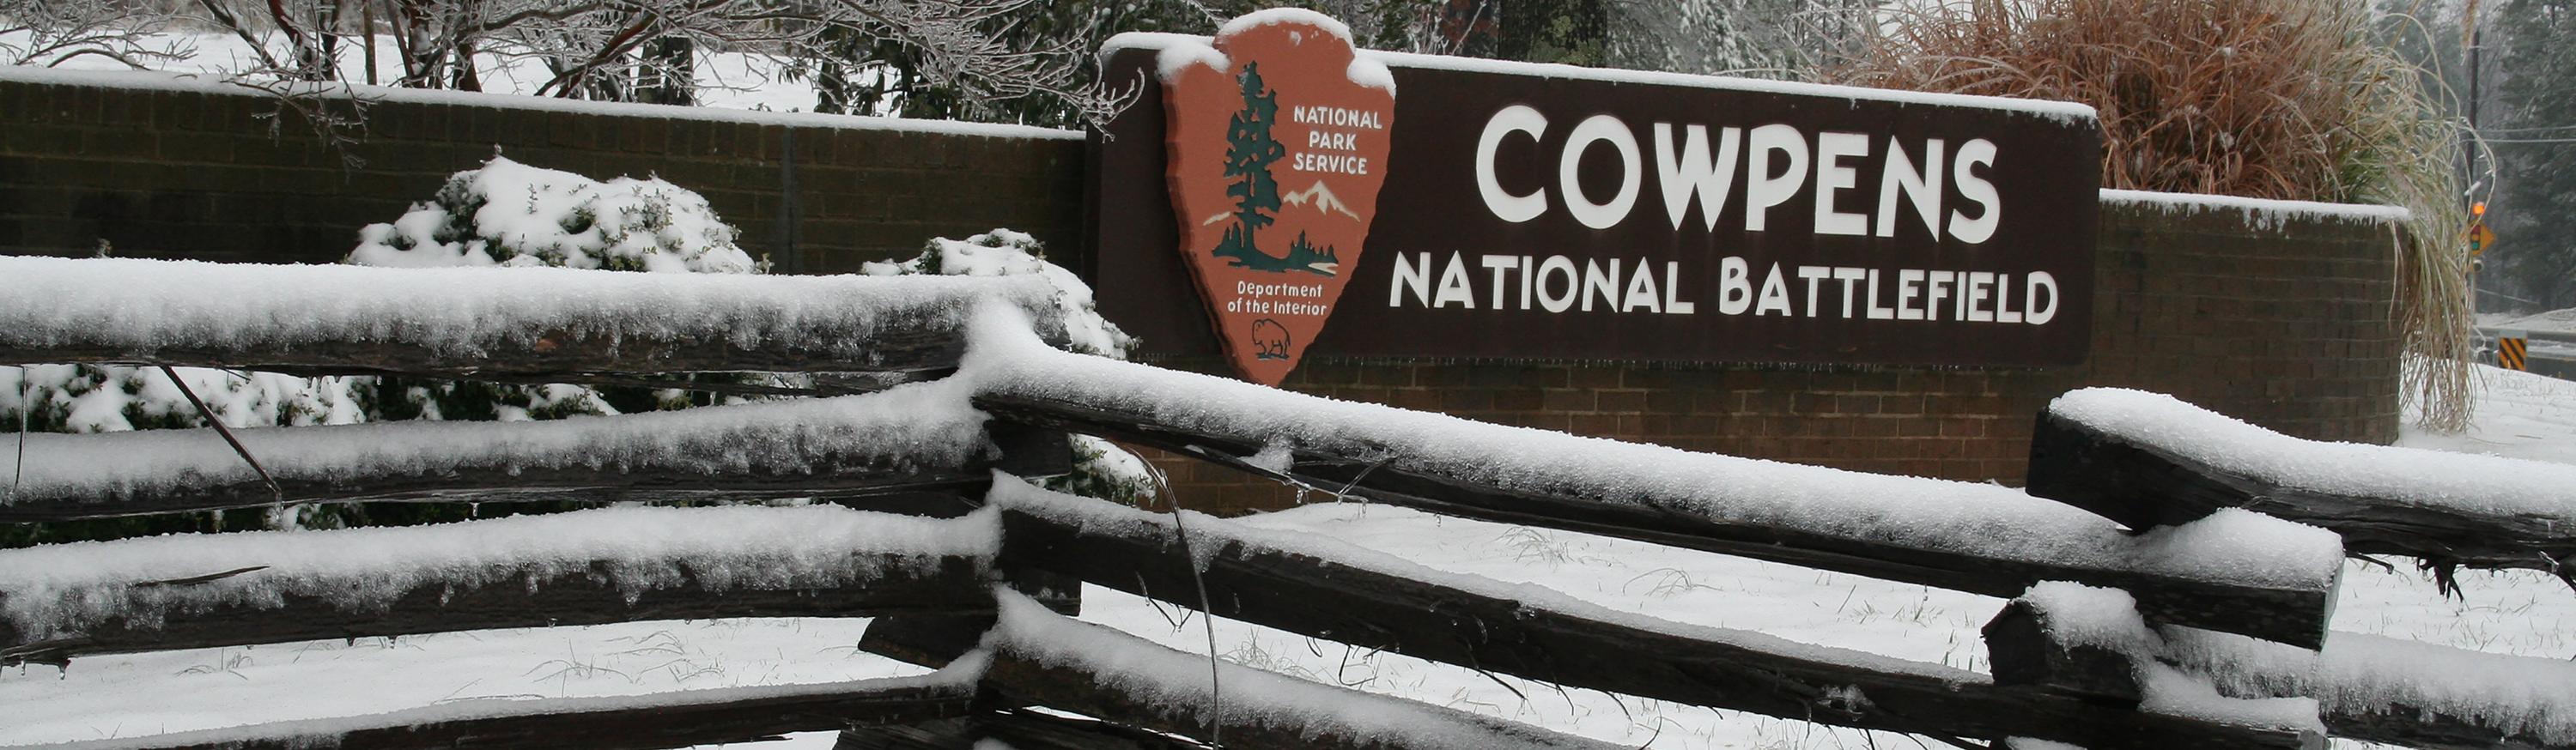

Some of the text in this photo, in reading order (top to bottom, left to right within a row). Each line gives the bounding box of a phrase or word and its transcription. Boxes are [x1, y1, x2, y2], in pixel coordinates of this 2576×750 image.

[1294, 106, 1382, 129] NATIONAL
[1309, 130, 1356, 150] PARK
[1293, 153, 1367, 174] SERVICE
[1476, 105, 2001, 243] COWPENS
[1238, 281, 1322, 298] Department
[1390, 251, 2057, 324] NATIONAL BATTLEFIELD
[1228, 298, 1327, 315] of the Interior
